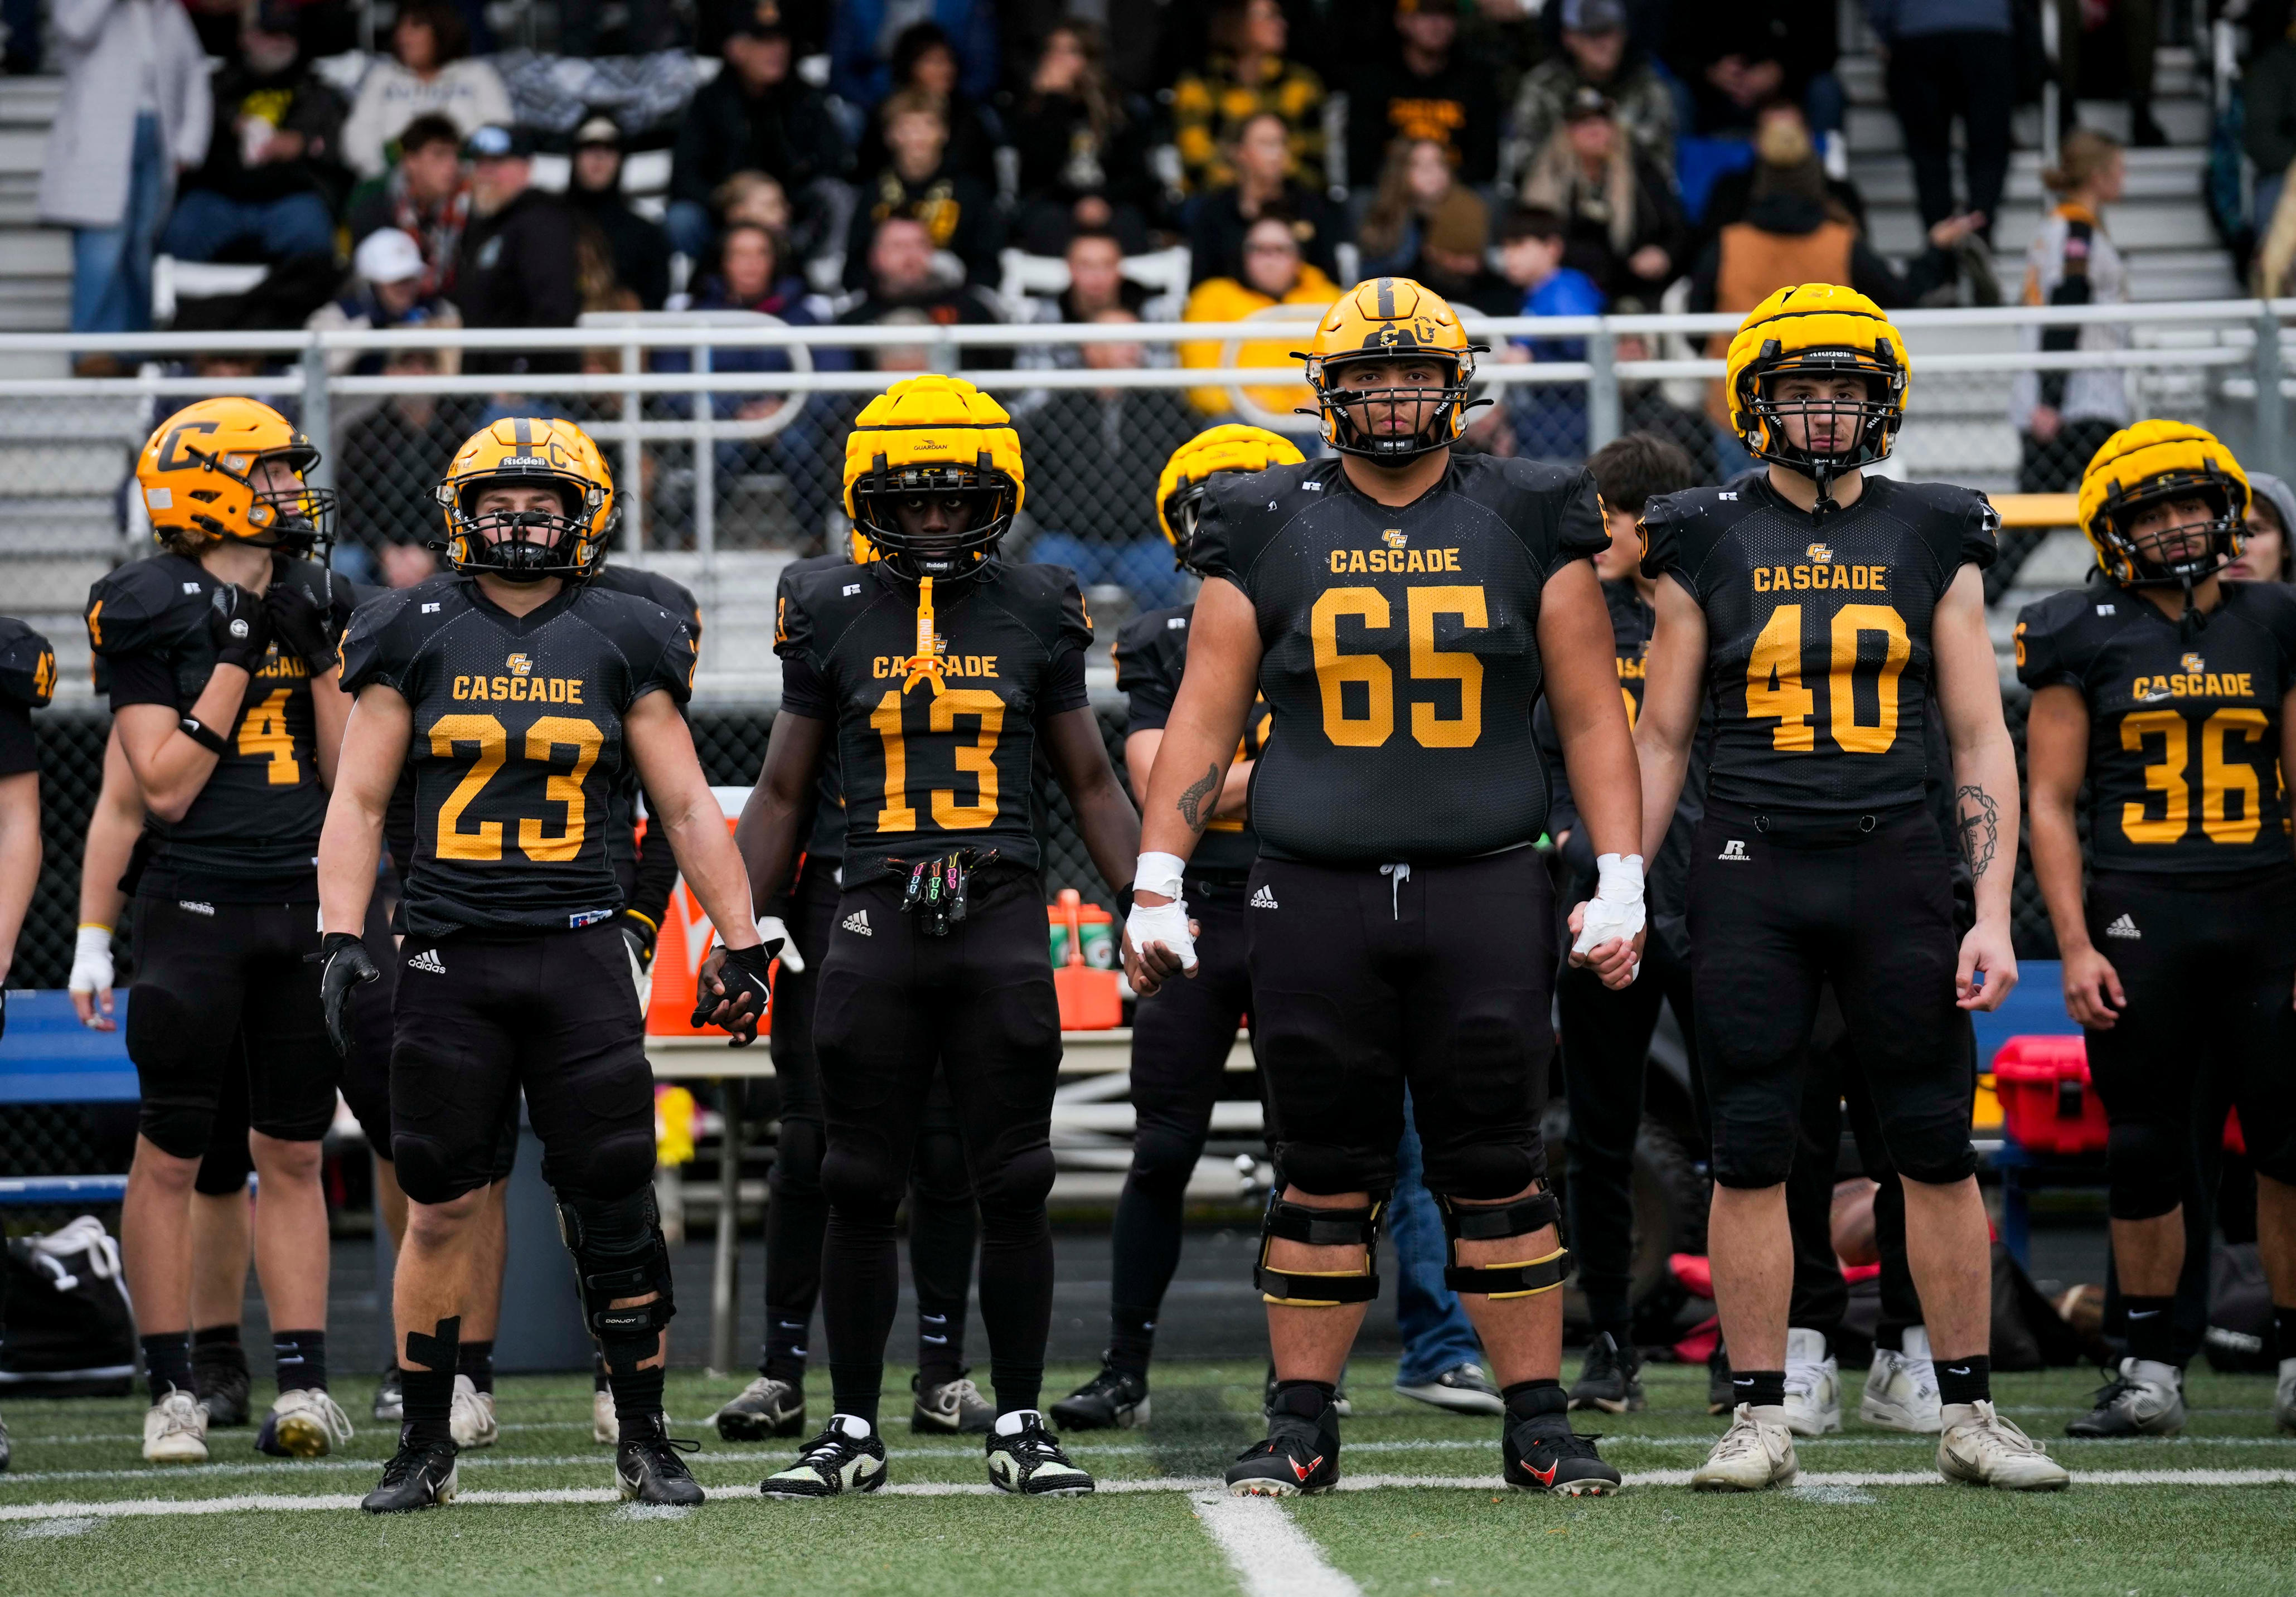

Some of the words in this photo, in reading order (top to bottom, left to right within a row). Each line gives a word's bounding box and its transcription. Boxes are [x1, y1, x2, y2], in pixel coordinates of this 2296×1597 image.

[503, 457, 546, 467] Riddell
[550, 442, 567, 469] C
[1331, 548, 1462, 574] CASCADE
[1754, 564, 1887, 592] CASCADE
[89, 600, 104, 646] 4
[873, 655, 1000, 679] CAADE
[1311, 585, 1489, 748] 65
[1745, 604, 1911, 754] 40
[453, 675, 584, 705] CASCADE
[238, 688, 300, 785] 4
[870, 689, 1006, 833] 13
[428, 713, 604, 862] 23
[2120, 707, 2269, 844] 36
[1724, 840, 1745, 855] R
[179, 900, 215, 916] adidas
[1250, 897, 1278, 909] adidas
[842, 920, 873, 936] adidas
[2106, 927, 2142, 939] adidas
[408, 959, 447, 974] adidas
